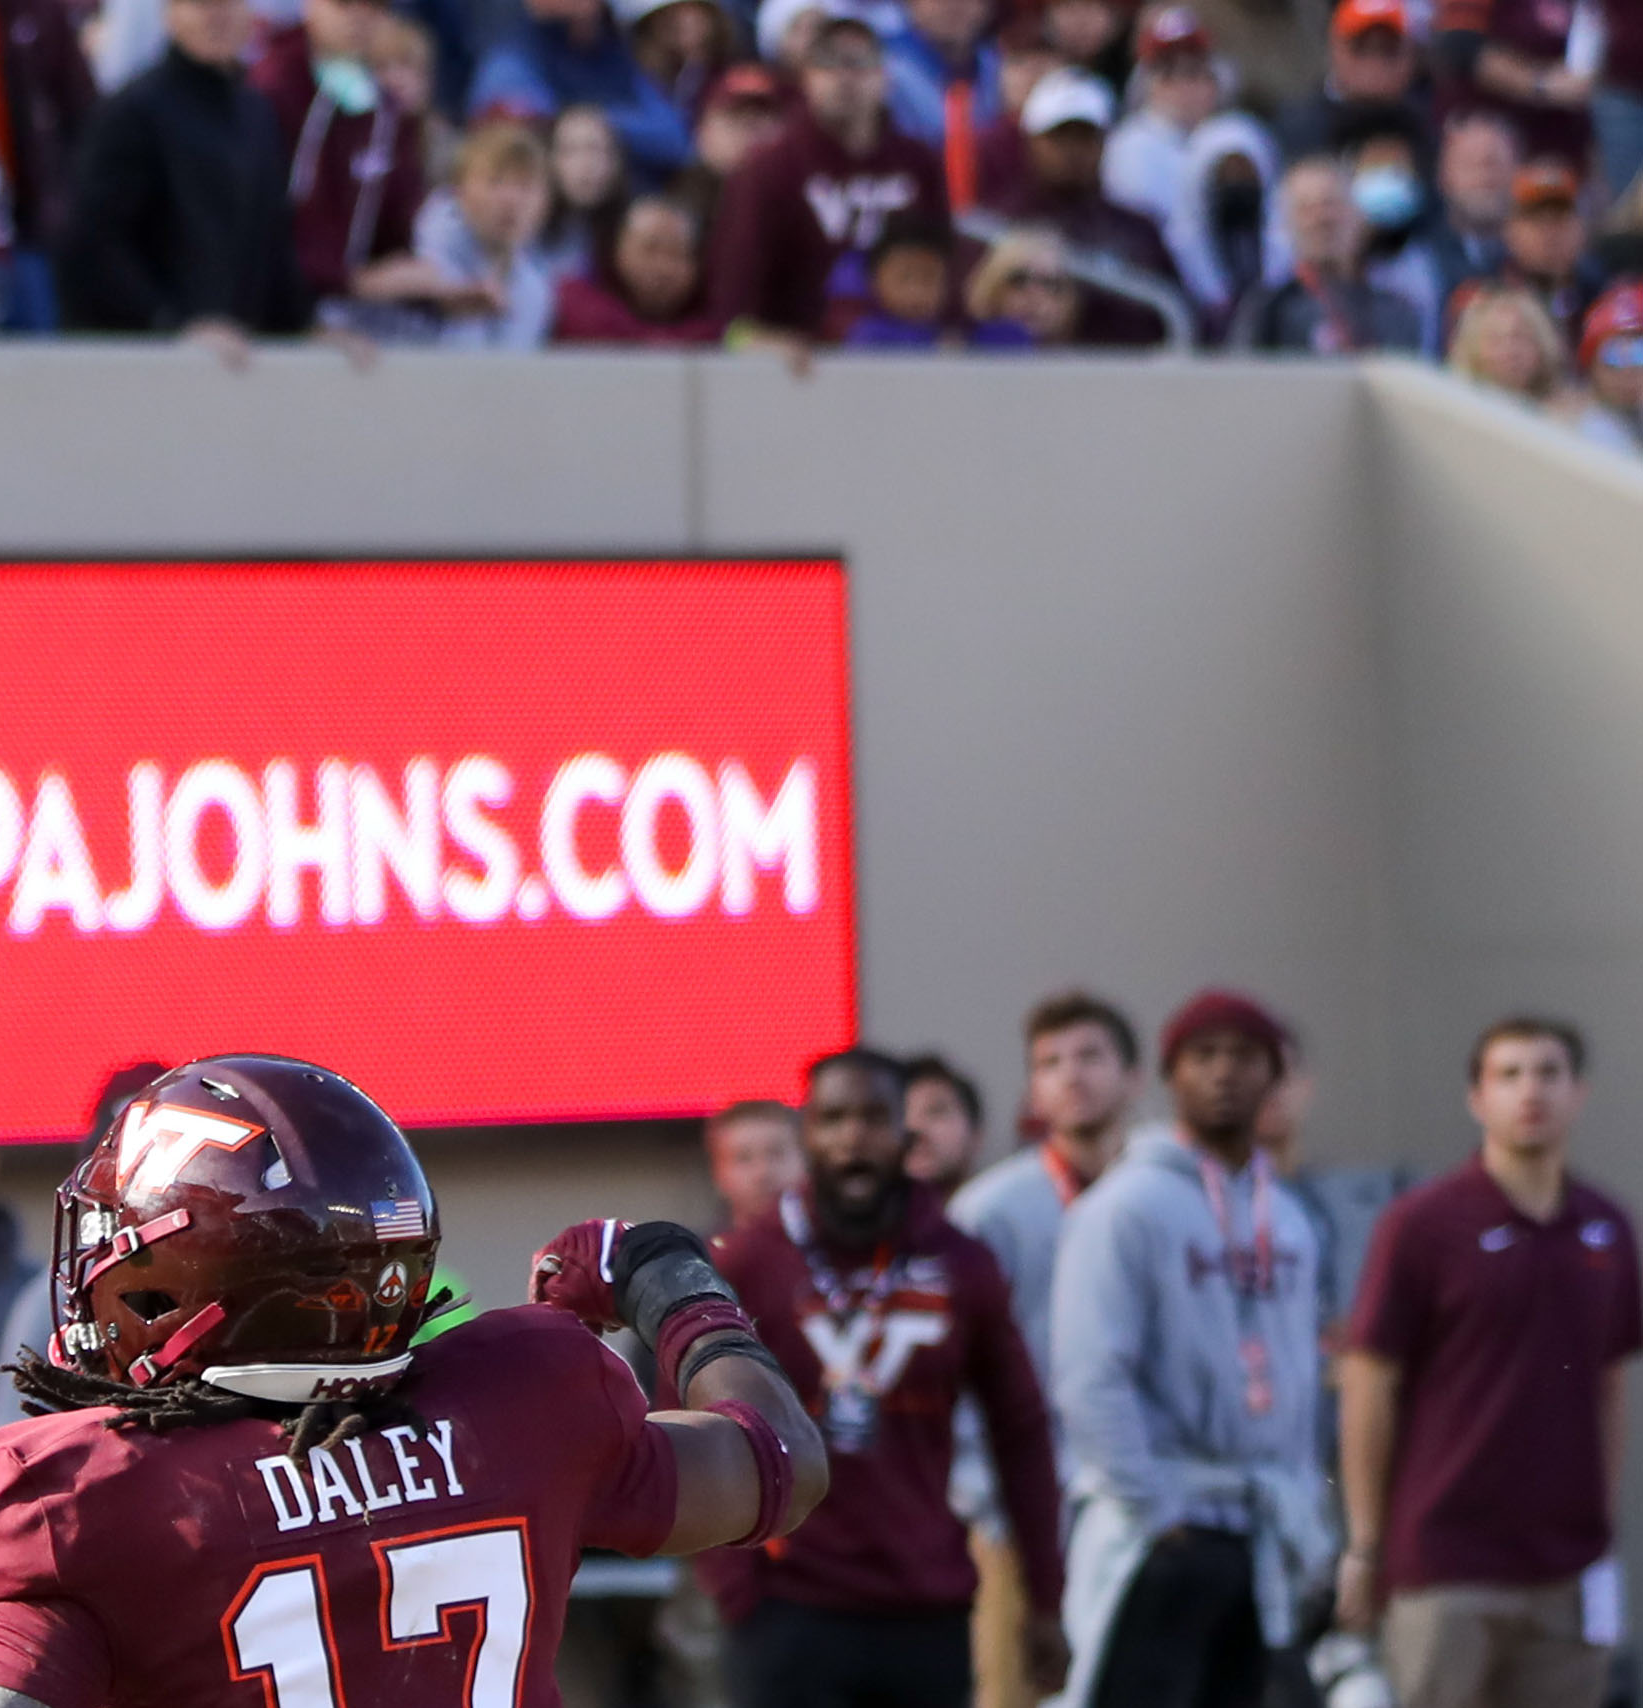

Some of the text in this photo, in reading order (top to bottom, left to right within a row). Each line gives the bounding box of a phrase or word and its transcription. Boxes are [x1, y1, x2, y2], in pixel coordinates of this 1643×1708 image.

[804, 174, 916, 250] VT
[116, 1100, 265, 1194] VT
[362, 1323, 399, 1356] 17
[255, 1419, 465, 1532] DALEY
